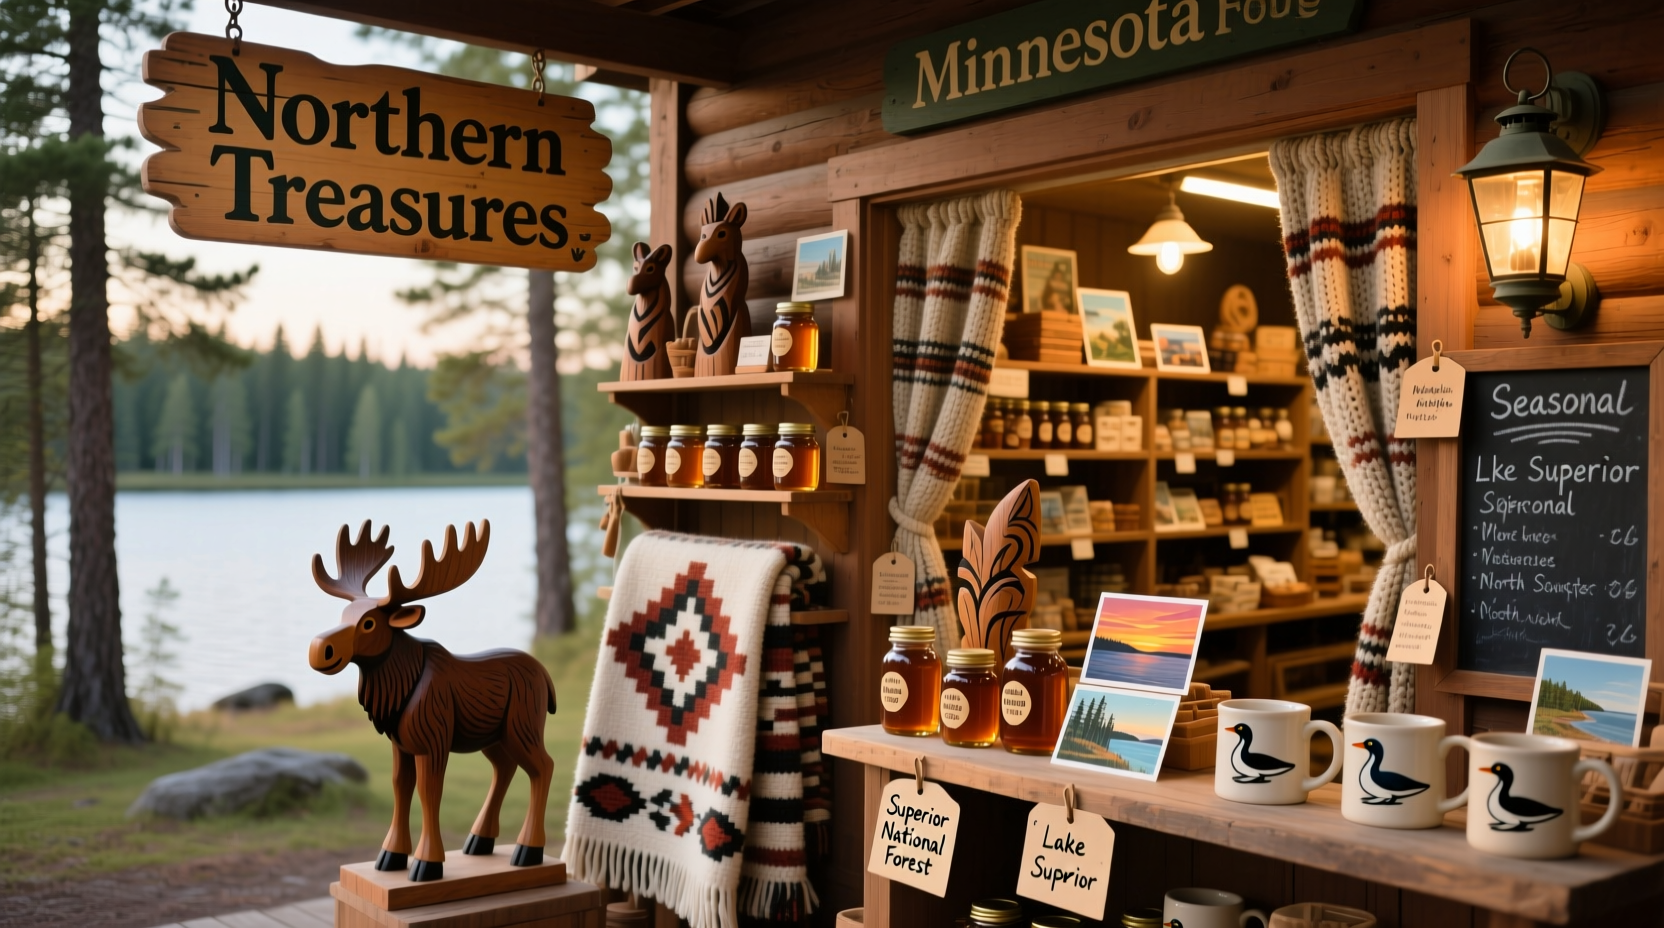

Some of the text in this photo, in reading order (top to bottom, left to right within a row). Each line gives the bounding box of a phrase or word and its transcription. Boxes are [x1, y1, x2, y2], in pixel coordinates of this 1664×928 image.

[912, 0, 1204, 109] Minnesota
[208, 54, 566, 176] Northern
[210, 144, 569, 250] Treasures
[1490, 379, 1634, 420] Seasonal
[1476, 454, 1640, 496] Lke Superior
[1479, 572, 1525, 591] North
[886, 794, 950, 828] Superior
[881, 821, 946, 856] National
[1042, 825, 1086, 857] Lake
[884, 845, 933, 876] Forest
[1030, 855, 1098, 892] Suprior
